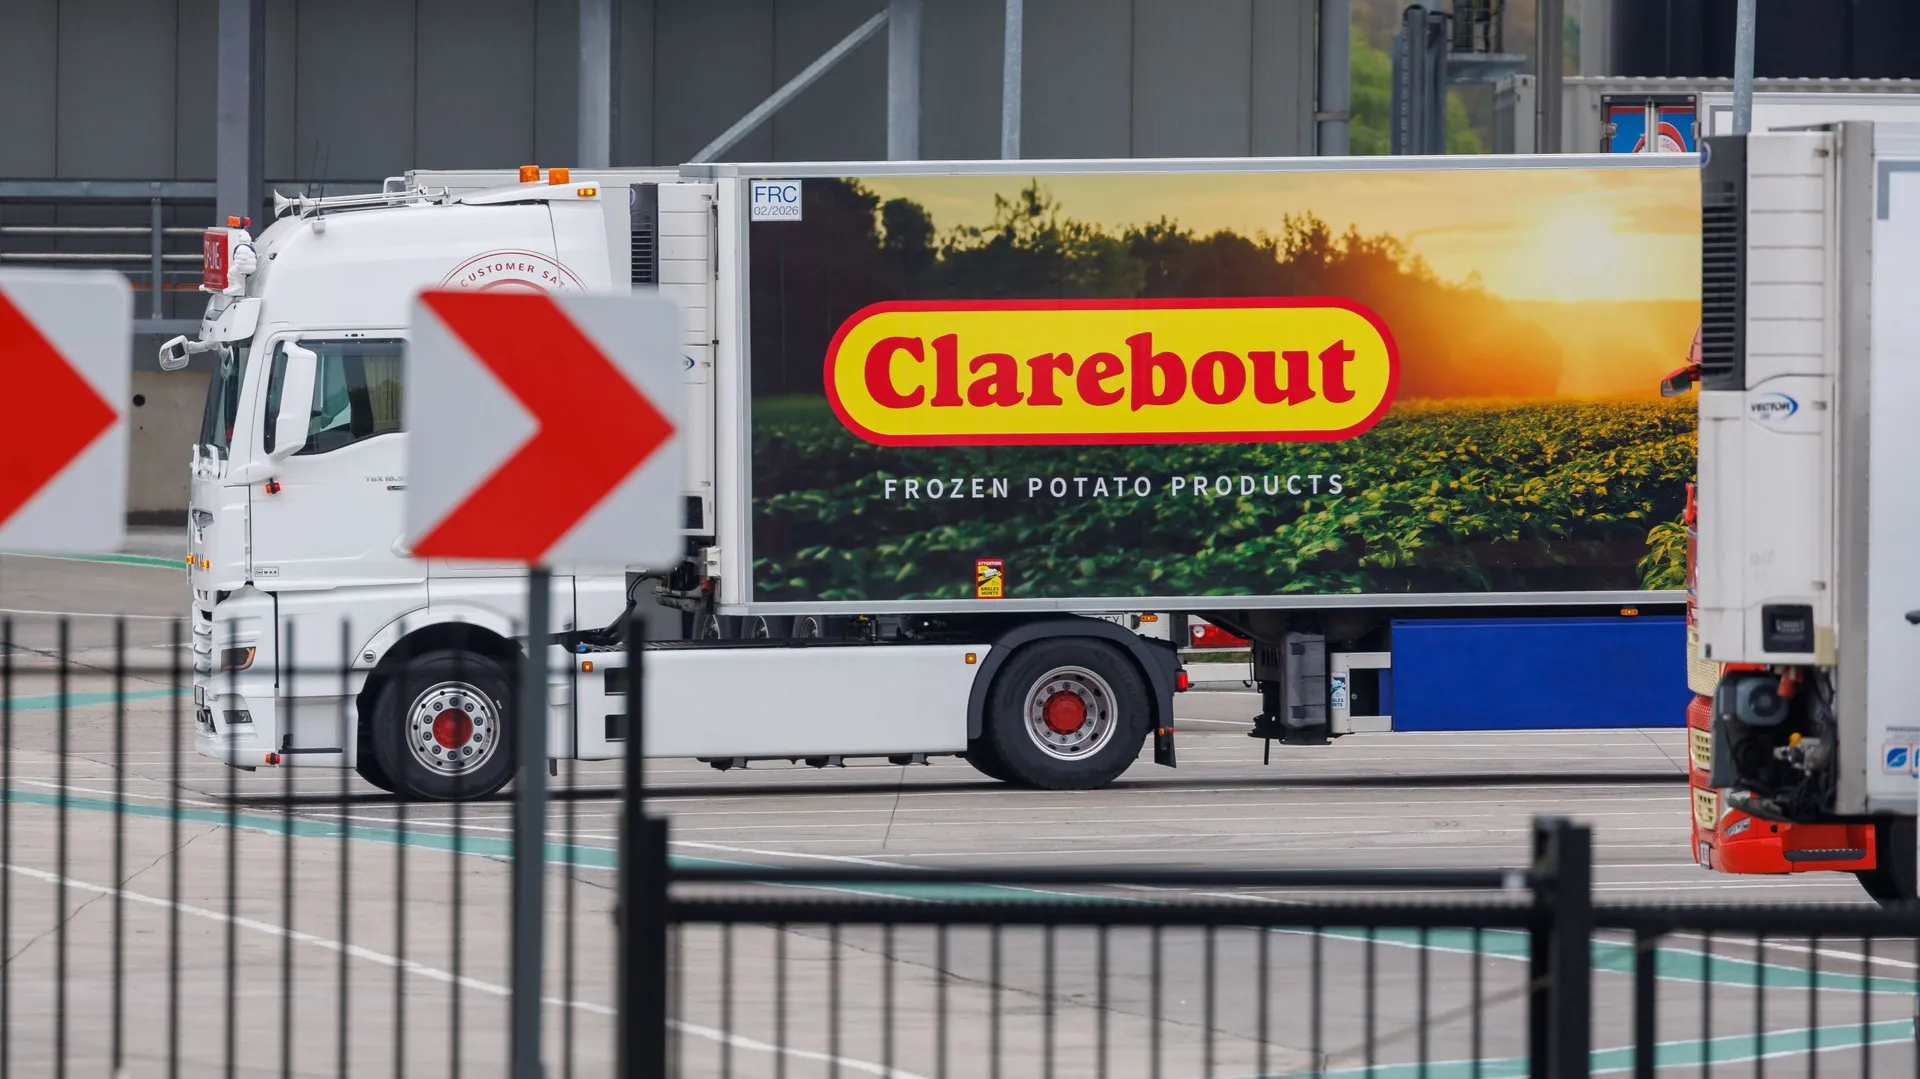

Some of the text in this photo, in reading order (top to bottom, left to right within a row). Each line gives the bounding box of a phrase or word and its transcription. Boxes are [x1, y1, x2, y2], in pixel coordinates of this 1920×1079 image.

[755, 185, 797, 203] FRC
[753, 205, 799, 216] 02/2026
[460, 262, 535, 288] CUSTOMER
[864, 332, 1356, 412] Clarebout
[884, 474, 1343, 499] FROZEN POTATO PRODUCTS
